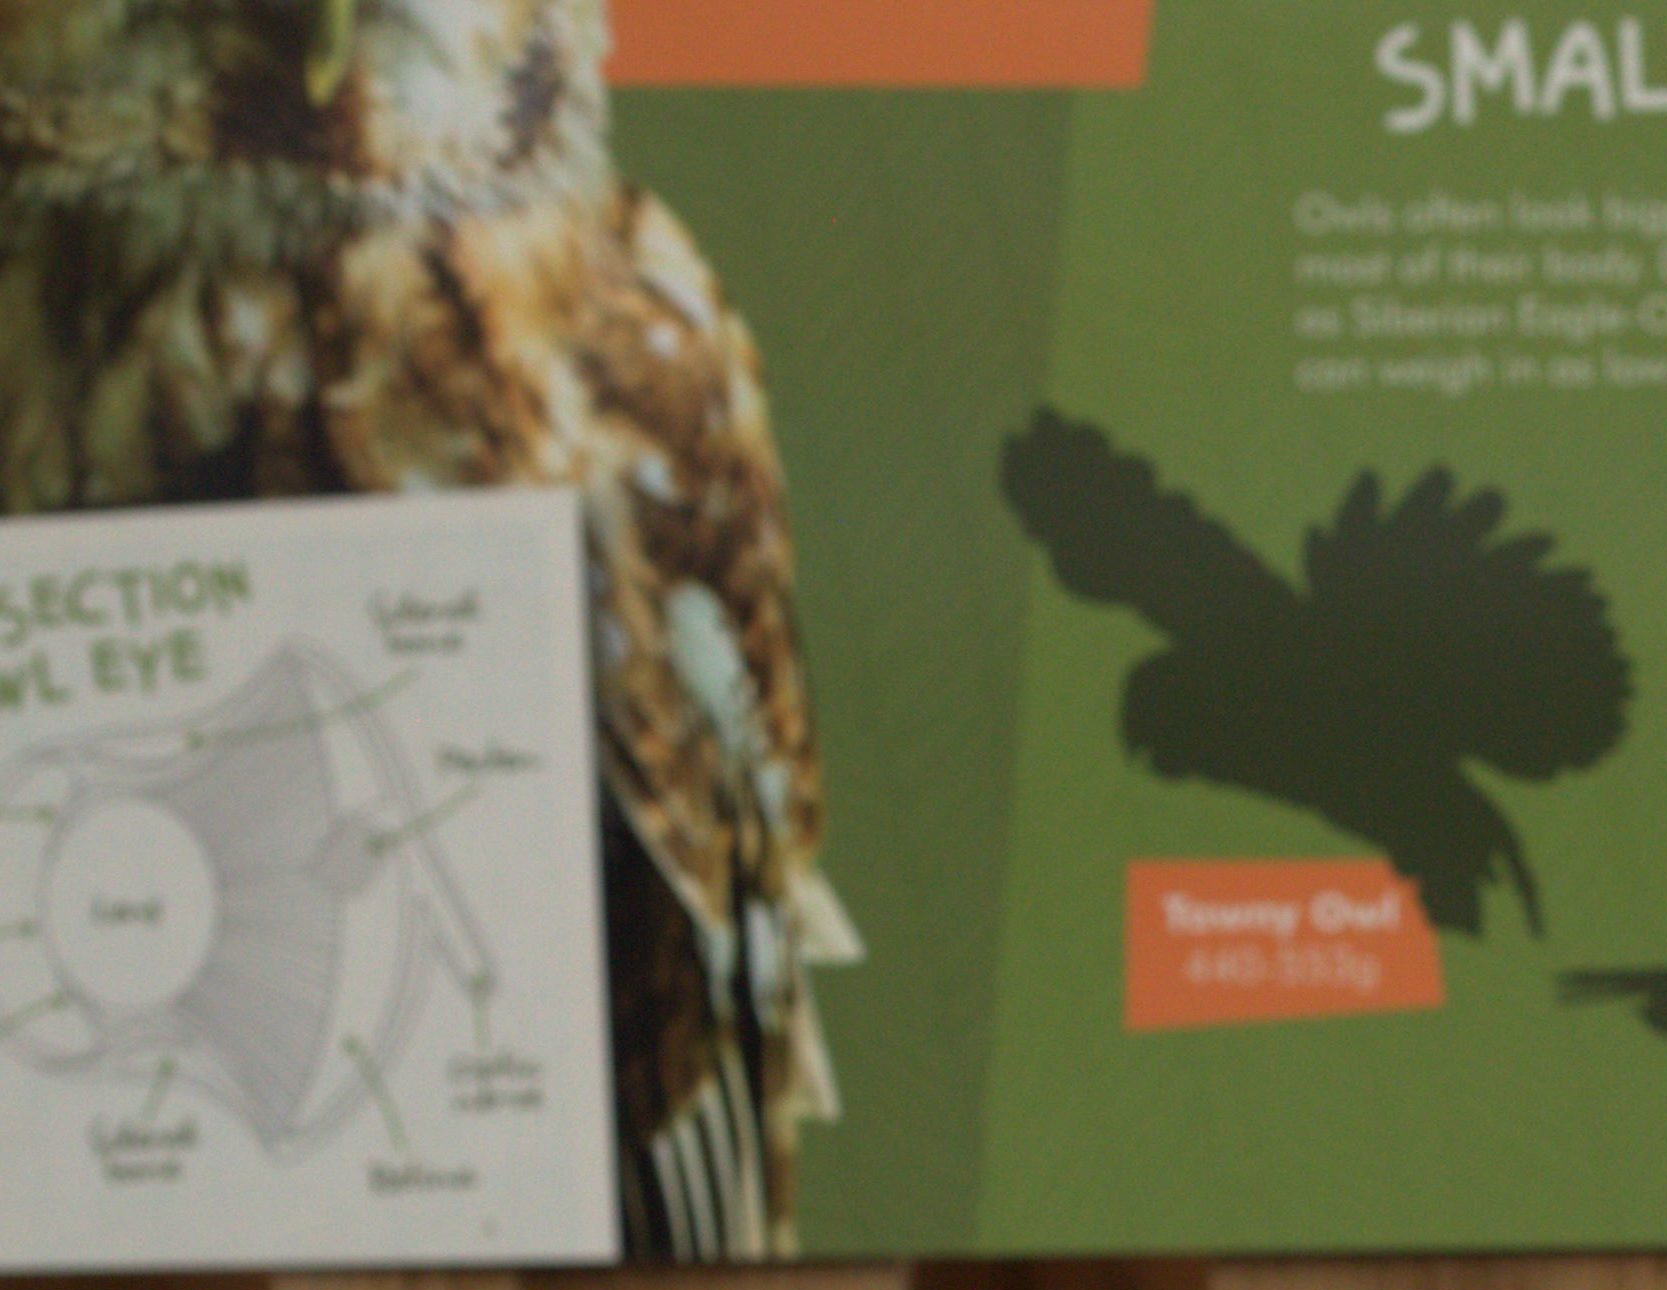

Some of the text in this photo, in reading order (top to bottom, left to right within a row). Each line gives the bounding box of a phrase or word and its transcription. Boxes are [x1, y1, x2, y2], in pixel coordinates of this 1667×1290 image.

[92, 629, 207, 694] EYE
[1162, 889, 1400, 938] Tawny Owl
